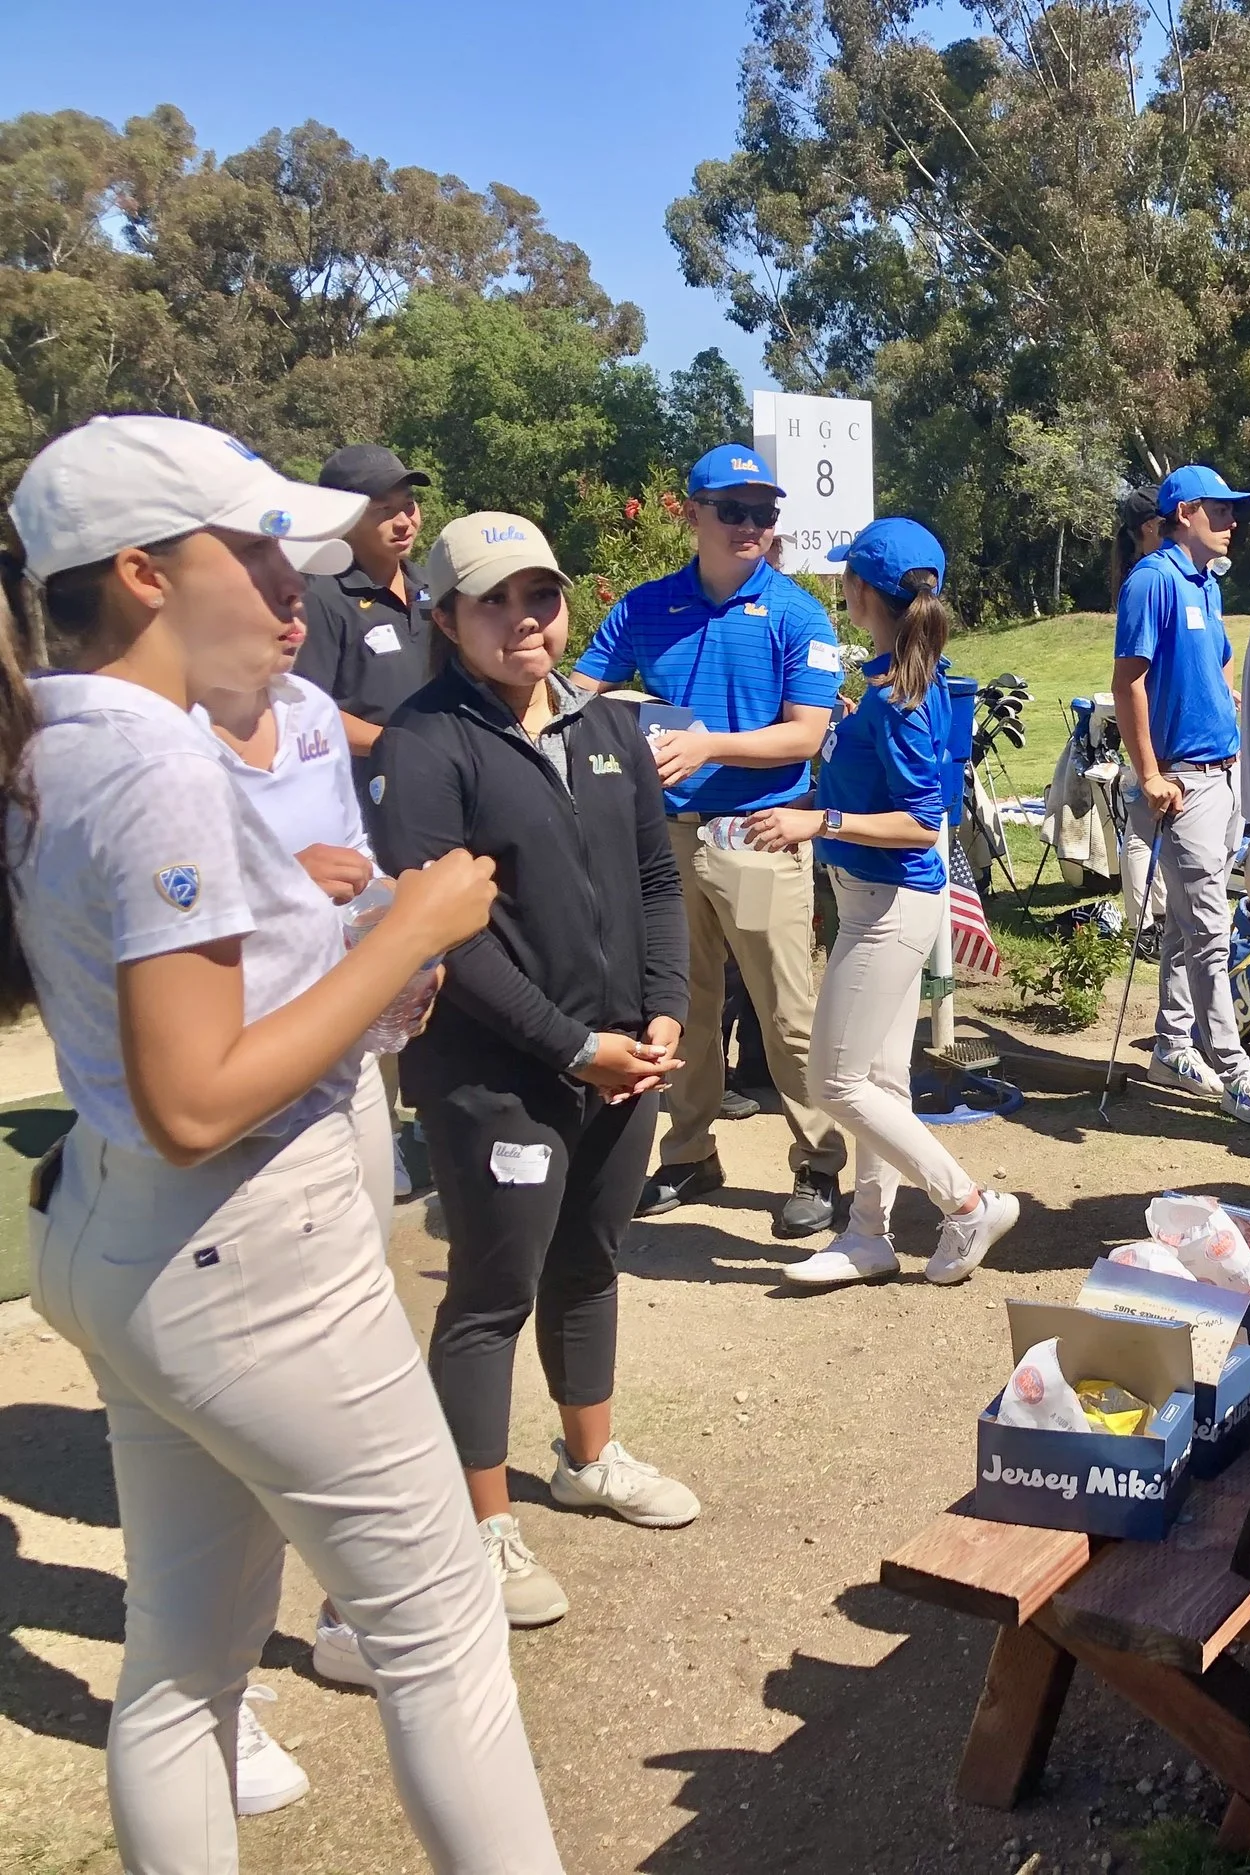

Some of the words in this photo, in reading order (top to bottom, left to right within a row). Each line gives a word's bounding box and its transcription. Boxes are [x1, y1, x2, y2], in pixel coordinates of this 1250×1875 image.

[788, 418, 801, 437] H
[819, 420, 832, 439] G
[848, 422, 860, 441] C
[816, 459, 835, 497] 8
[792, 530, 822, 550] 135
[982, 1454, 1079, 1500] Jersey
